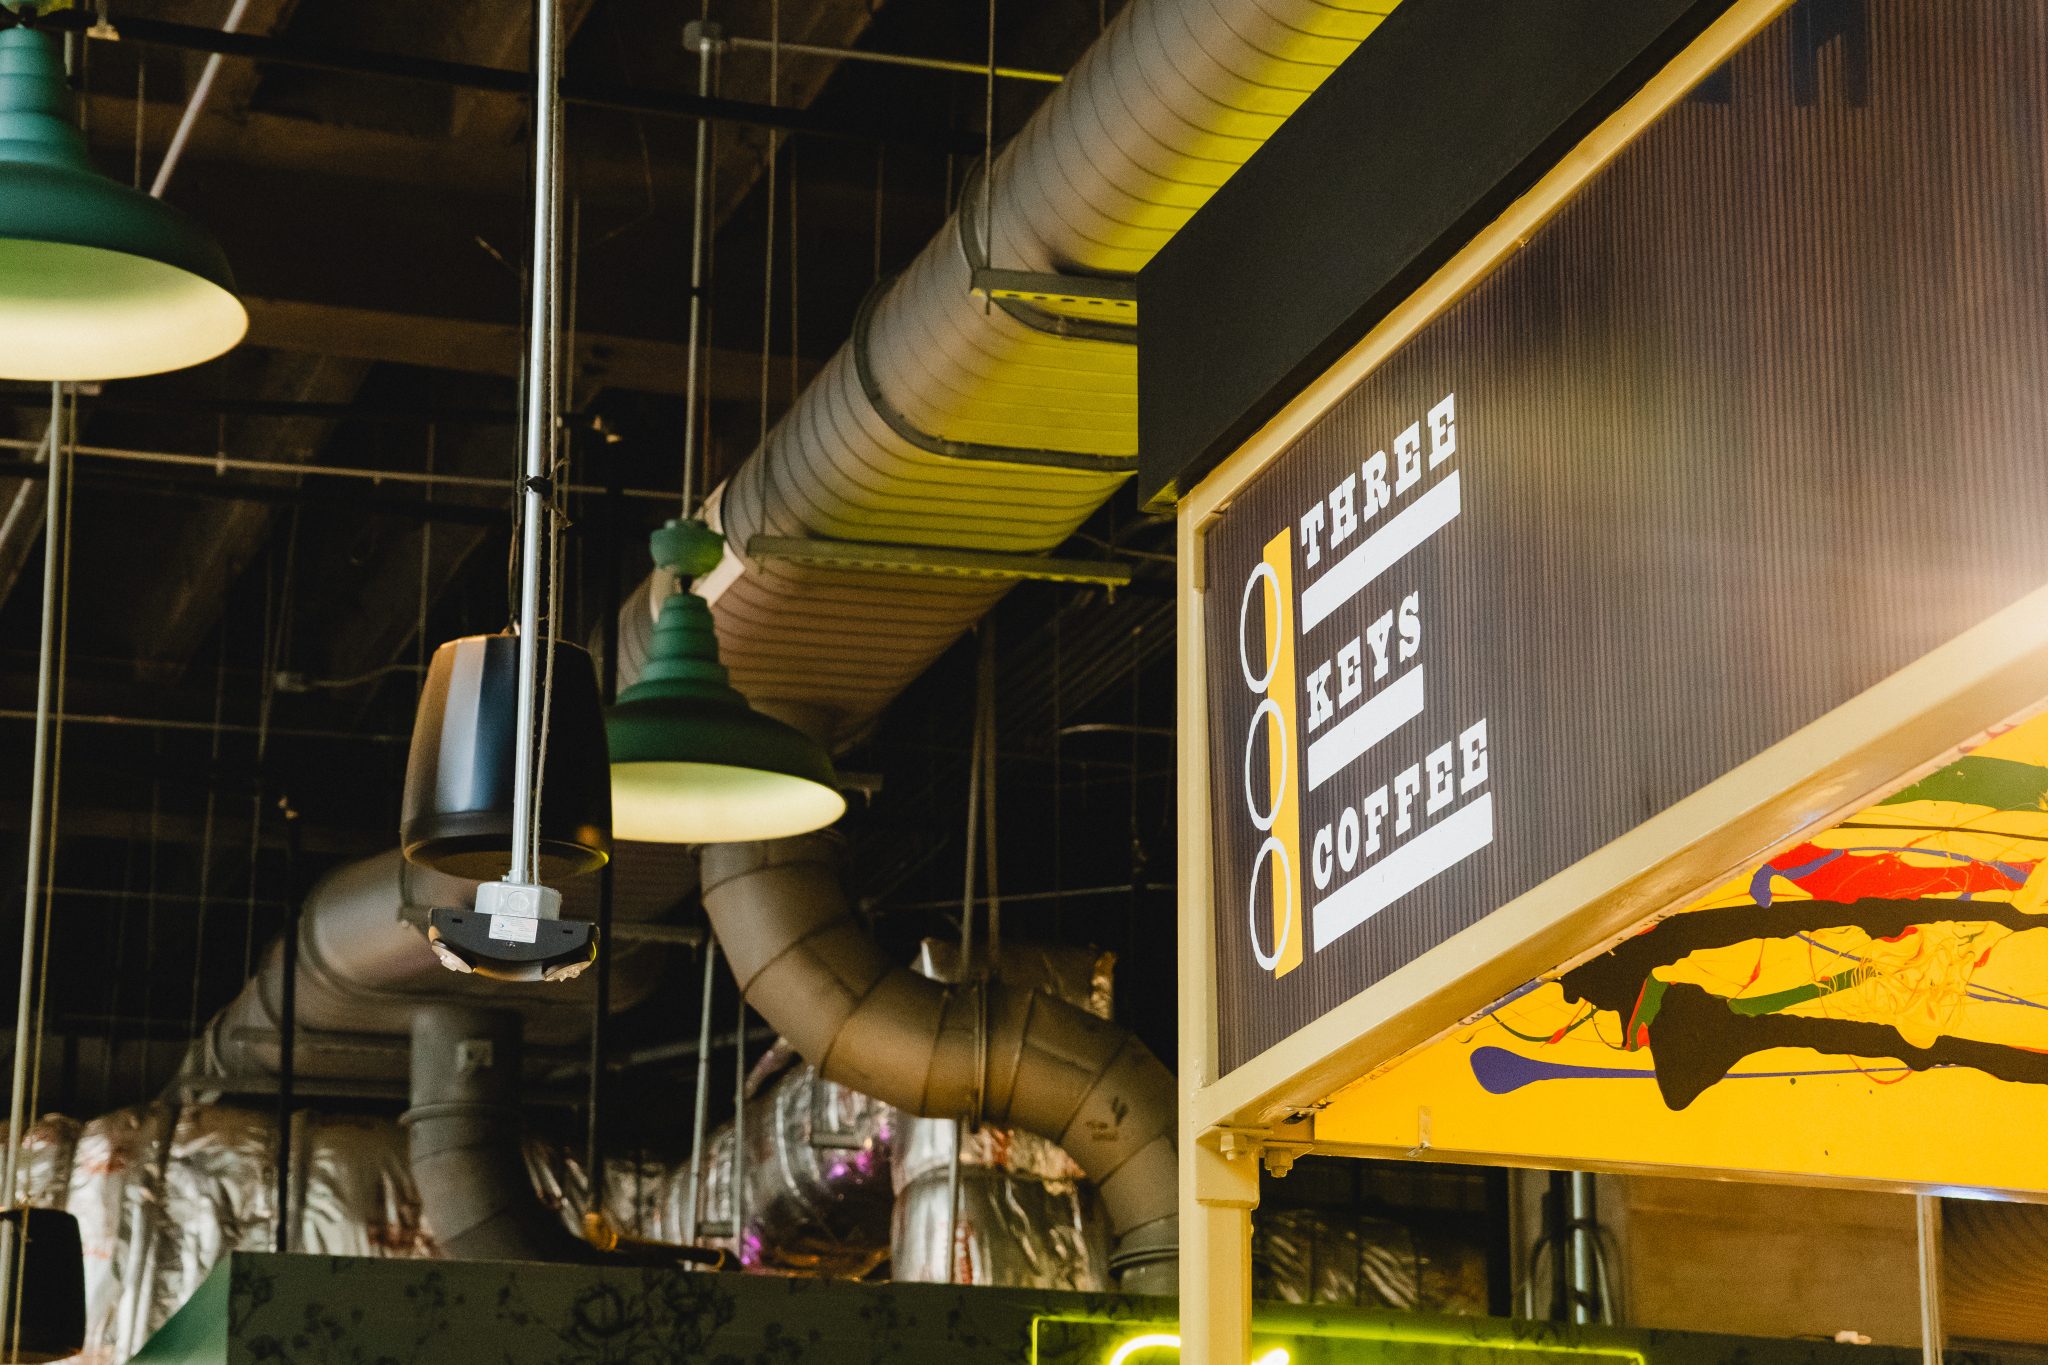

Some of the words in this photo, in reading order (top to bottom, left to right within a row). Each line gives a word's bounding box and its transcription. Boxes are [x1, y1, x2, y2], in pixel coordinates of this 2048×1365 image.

[1300, 392, 1457, 570] THREE
[1306, 589, 1422, 734] KEYS
[1311, 717, 1489, 891] COFFEE
